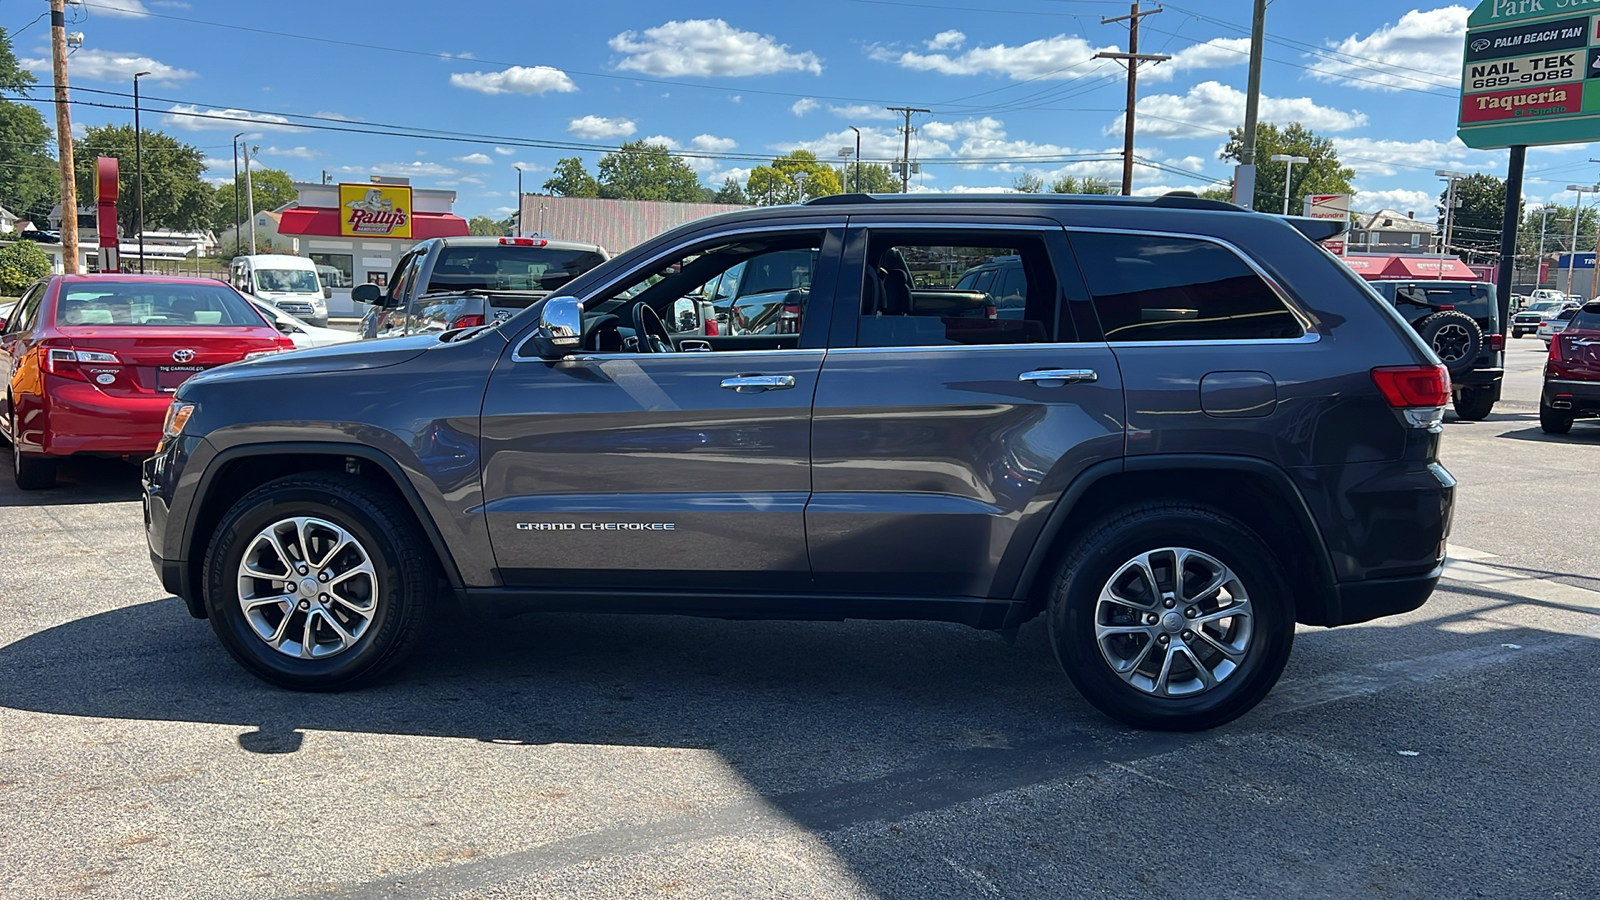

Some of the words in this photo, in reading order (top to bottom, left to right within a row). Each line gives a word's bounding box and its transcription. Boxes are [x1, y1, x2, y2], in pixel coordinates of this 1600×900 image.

[1491, 0, 1545, 18] Park
[1494, 35, 1521, 48] PALM
[1523, 30, 1559, 44] BEACH
[1561, 26, 1583, 38] TAN
[1471, 62, 1520, 78] NAIL
[1529, 53, 1576, 71] TEK
[1472, 68, 1573, 89] 689-9088
[347, 207, 407, 233] Rally's
[516, 522, 576, 531] GRAND
[580, 522, 675, 531] CHEROKEE
